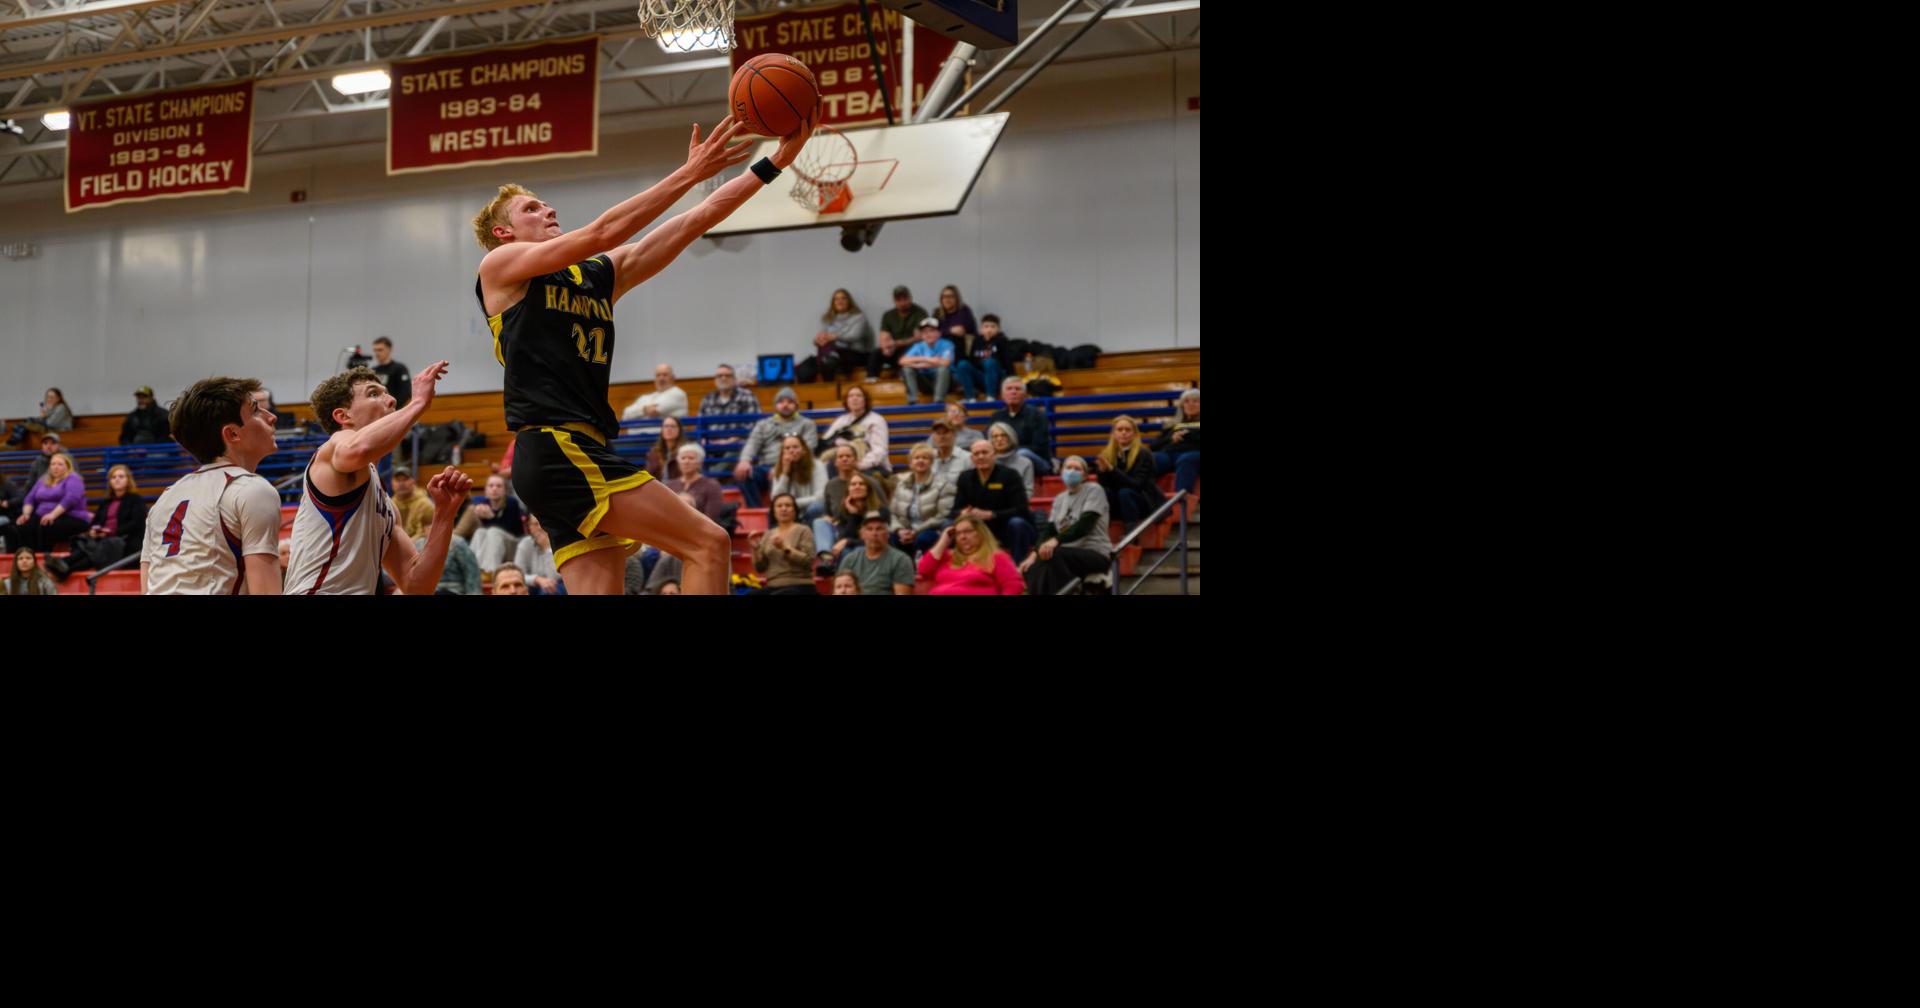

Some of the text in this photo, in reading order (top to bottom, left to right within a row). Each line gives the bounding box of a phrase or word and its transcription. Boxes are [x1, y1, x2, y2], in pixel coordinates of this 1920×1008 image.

[743, 9, 903, 49] VT. STATE CHAM
[401, 54, 586, 95] STATE CHAMPIONS
[77, 91, 246, 132] VT. STATE CHAMPIONS
[440, 92, 542, 120] 1983-84
[113, 122, 204, 147] DIVISION I
[429, 122, 553, 154] WRESTLING
[80, 159, 234, 198] FIELD HOCKEY
[161, 499, 190, 558] 4
